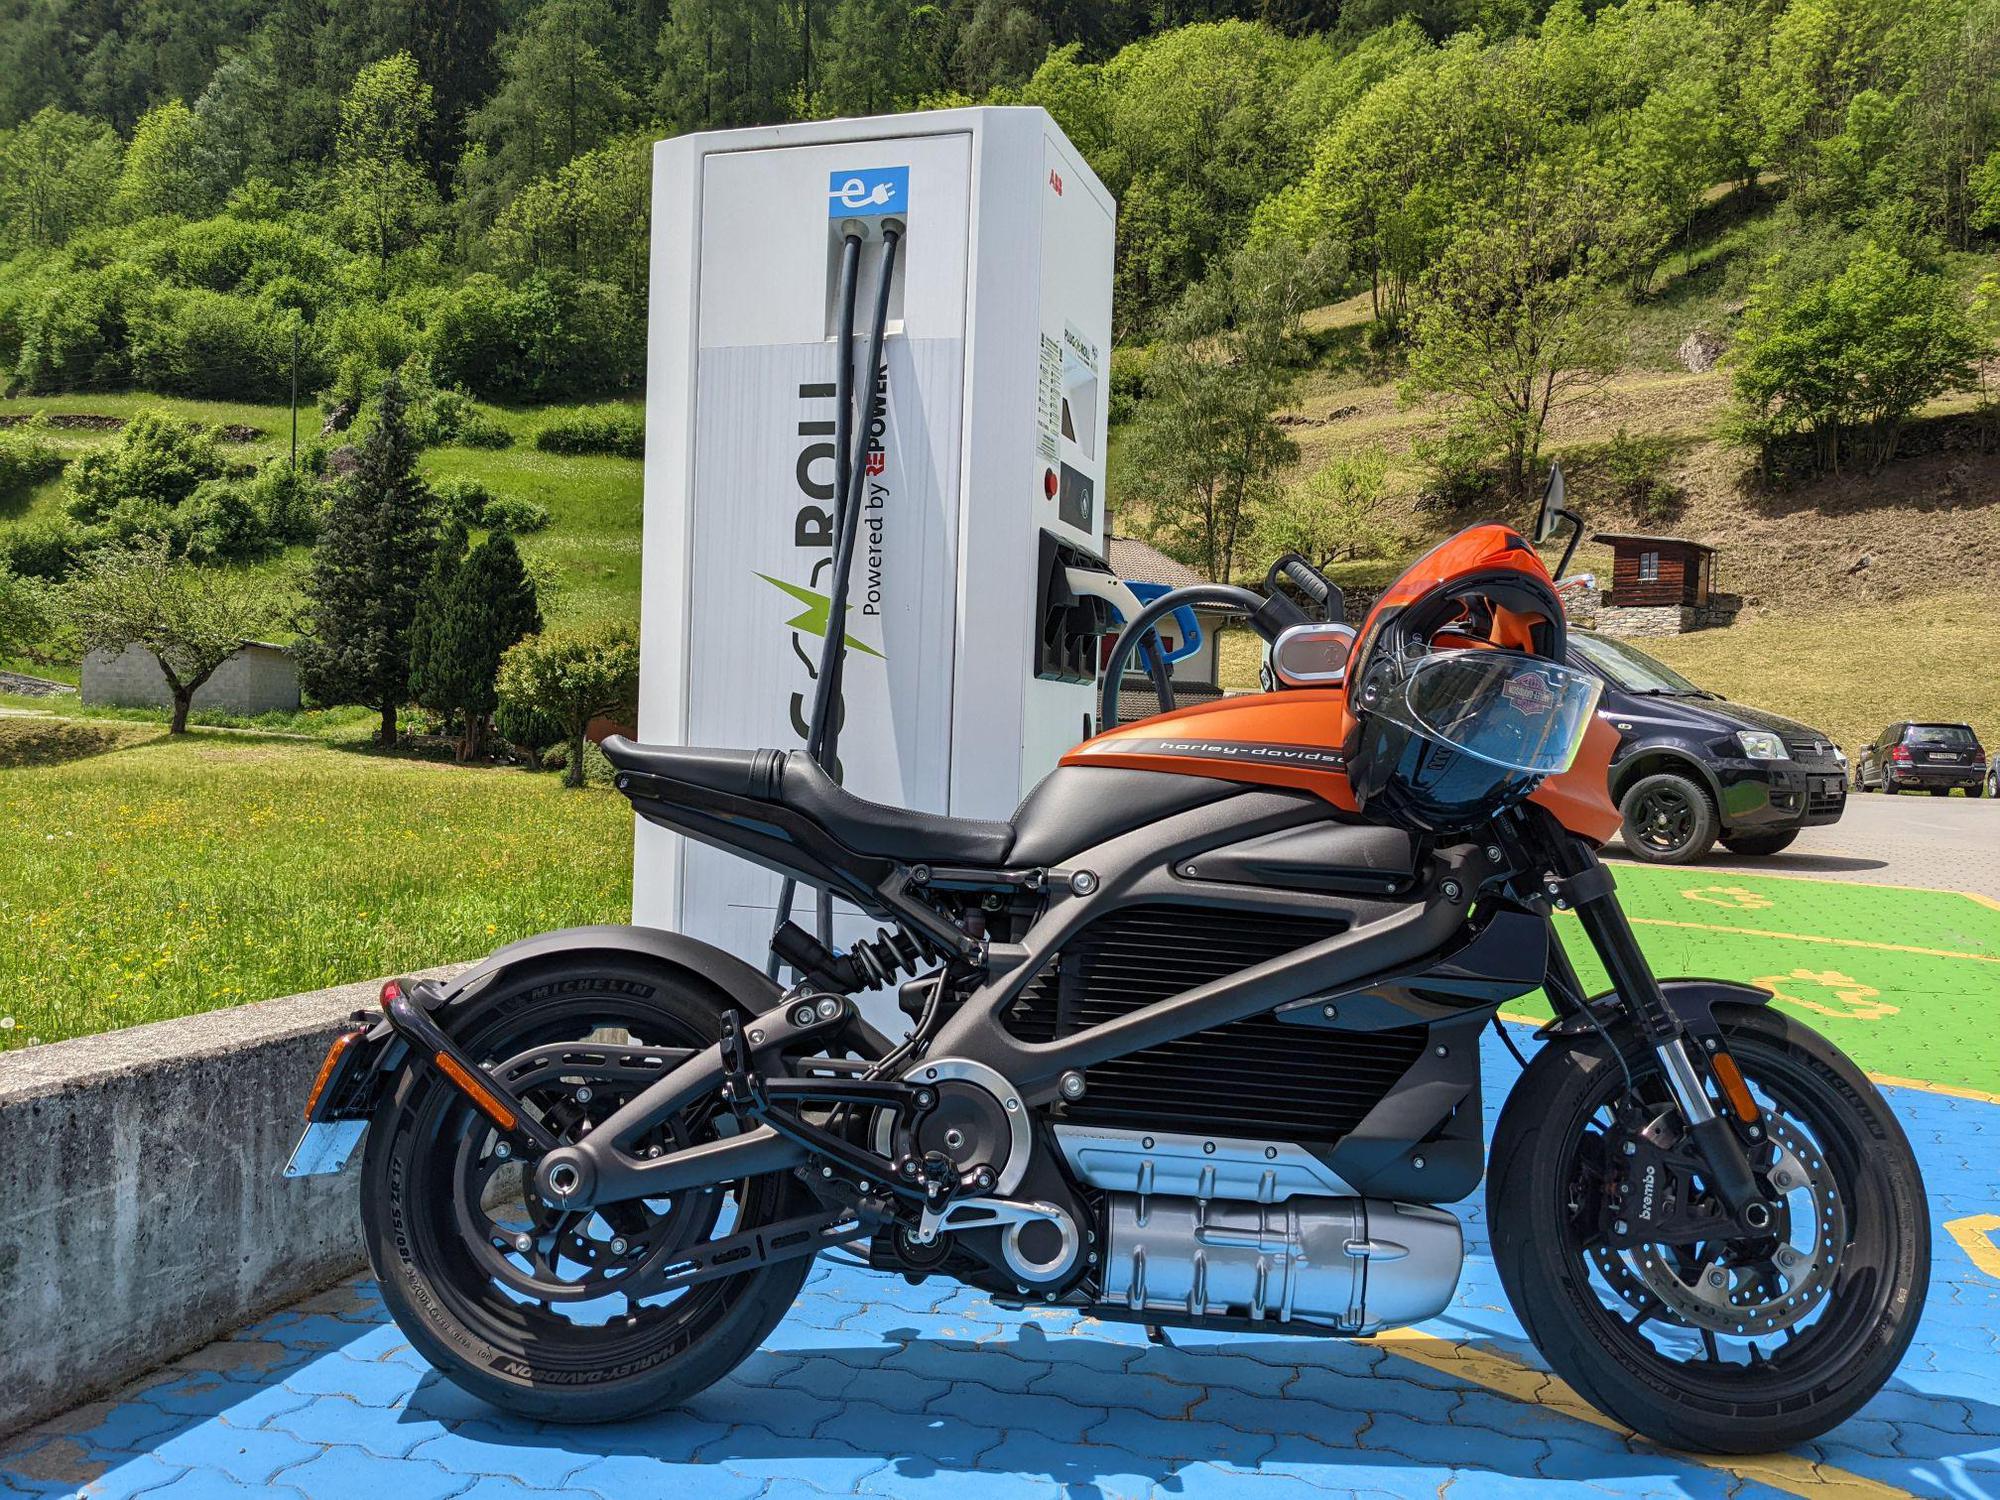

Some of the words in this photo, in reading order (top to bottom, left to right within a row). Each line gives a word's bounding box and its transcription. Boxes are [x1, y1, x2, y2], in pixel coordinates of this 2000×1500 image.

[865, 482, 890, 511] by
[863, 518, 884, 616] Powered
[1159, 741, 1345, 764] harley-davids
[530, 978, 649, 1001] MICHELIN
[1811, 1060, 1885, 1140] MICHELIN
[392, 1158, 402, 1177] 17
[391, 1180, 402, 1205] ZR
[1638, 1165, 1656, 1221] brembo
[391, 1207, 412, 1265] 180/55
[504, 1343, 675, 1384] HARLEY-DAVIDSON
